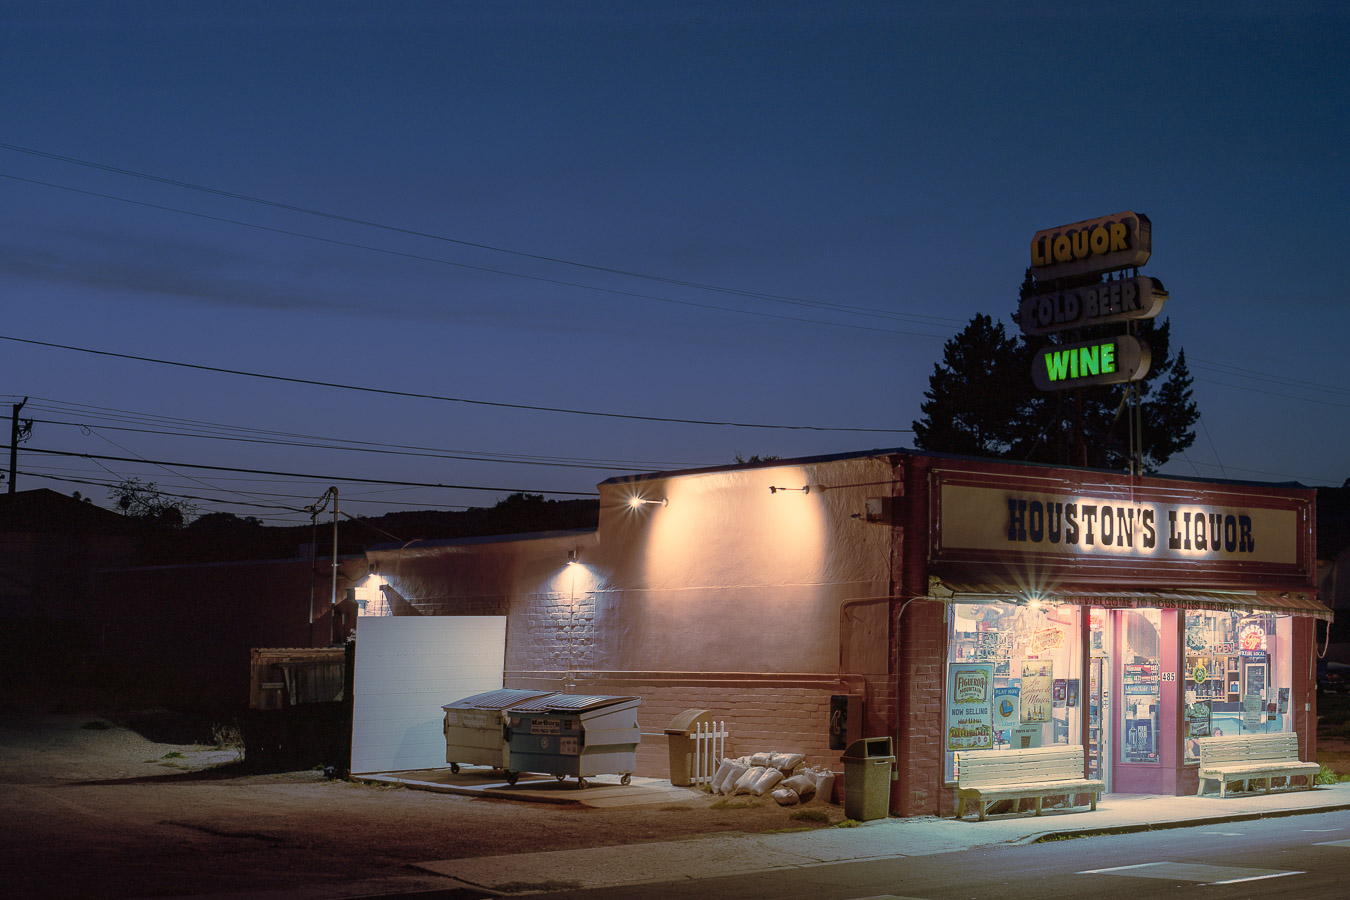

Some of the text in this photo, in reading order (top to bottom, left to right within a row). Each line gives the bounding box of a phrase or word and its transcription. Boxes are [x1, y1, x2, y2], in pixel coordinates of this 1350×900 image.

[1031, 222, 1128, 268] LIQUOR
[1030, 281, 1139, 329] COLD BEER
[1044, 342, 1116, 381] WINE
[1007, 499, 1255, 553] HOUSTON'S LIQUOR
[1084, 596, 1132, 607] WELCOME
[1137, 598, 1148, 608] TO
[1202, 602, 1234, 612] LIQUOR
[1213, 643, 1233, 653] OPEN
[1162, 672, 1175, 681] 485
[951, 707, 988, 716] NOW SELLING
[531, 719, 560, 727] MarBorg
